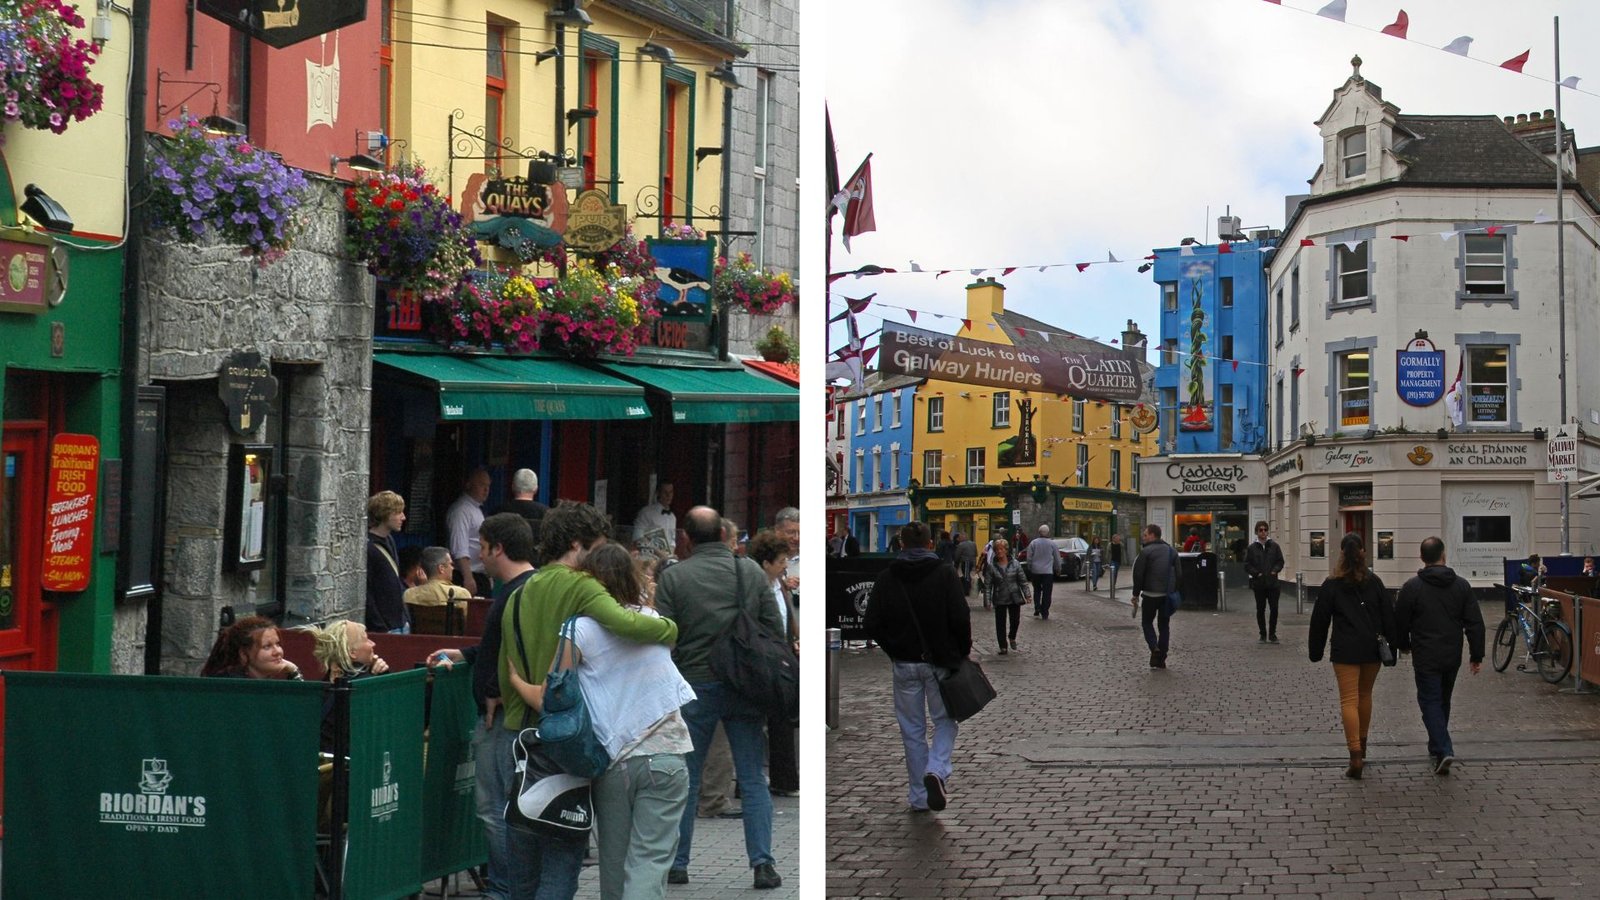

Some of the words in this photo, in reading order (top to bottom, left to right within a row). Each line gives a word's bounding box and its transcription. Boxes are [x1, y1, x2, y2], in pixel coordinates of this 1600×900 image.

[505, 183, 528, 196] THE
[487, 193, 542, 216] QUAYS
[574, 214, 610, 228] PUB
[895, 331, 935, 348] Best
[938, 338, 955, 351] of
[959, 342, 995, 358] Luck
[998, 349, 1014, 360] to
[1016, 352, 1041, 364] the
[893, 349, 970, 379] Galway
[975, 361, 1042, 385] Hurlers
[1079, 354, 1132, 374] LATIN
[1400, 357, 1441, 367] GORMALLY
[1068, 365, 1137, 389] QUARTER
[1406, 370, 1434, 379] PROPERTY
[1400, 380, 1442, 388] MANAGEMENT
[53, 444, 98, 455] RIORDAN'S
[1548, 440, 1575, 454] GALWAY
[52, 456, 95, 469] Traditional
[1548, 453, 1575, 467] MARKET
[59, 471, 87, 481] IRISH
[1166, 463, 1248, 482] Claddagh
[57, 481, 86, 492] FOOD
[1172, 481, 1237, 494] Jewellers
[945, 499, 986, 508] EVERGREEN
[100, 793, 206, 816] RIORDAN'S
[100, 812, 155, 822] TRADITIONAL
[157, 815, 179, 823] IRISH
[181, 816, 206, 824] FOOD
[560, 809, 585, 823] PUMA
[125, 824, 148, 832] OPEN
[157, 825, 179, 834] DAYS
